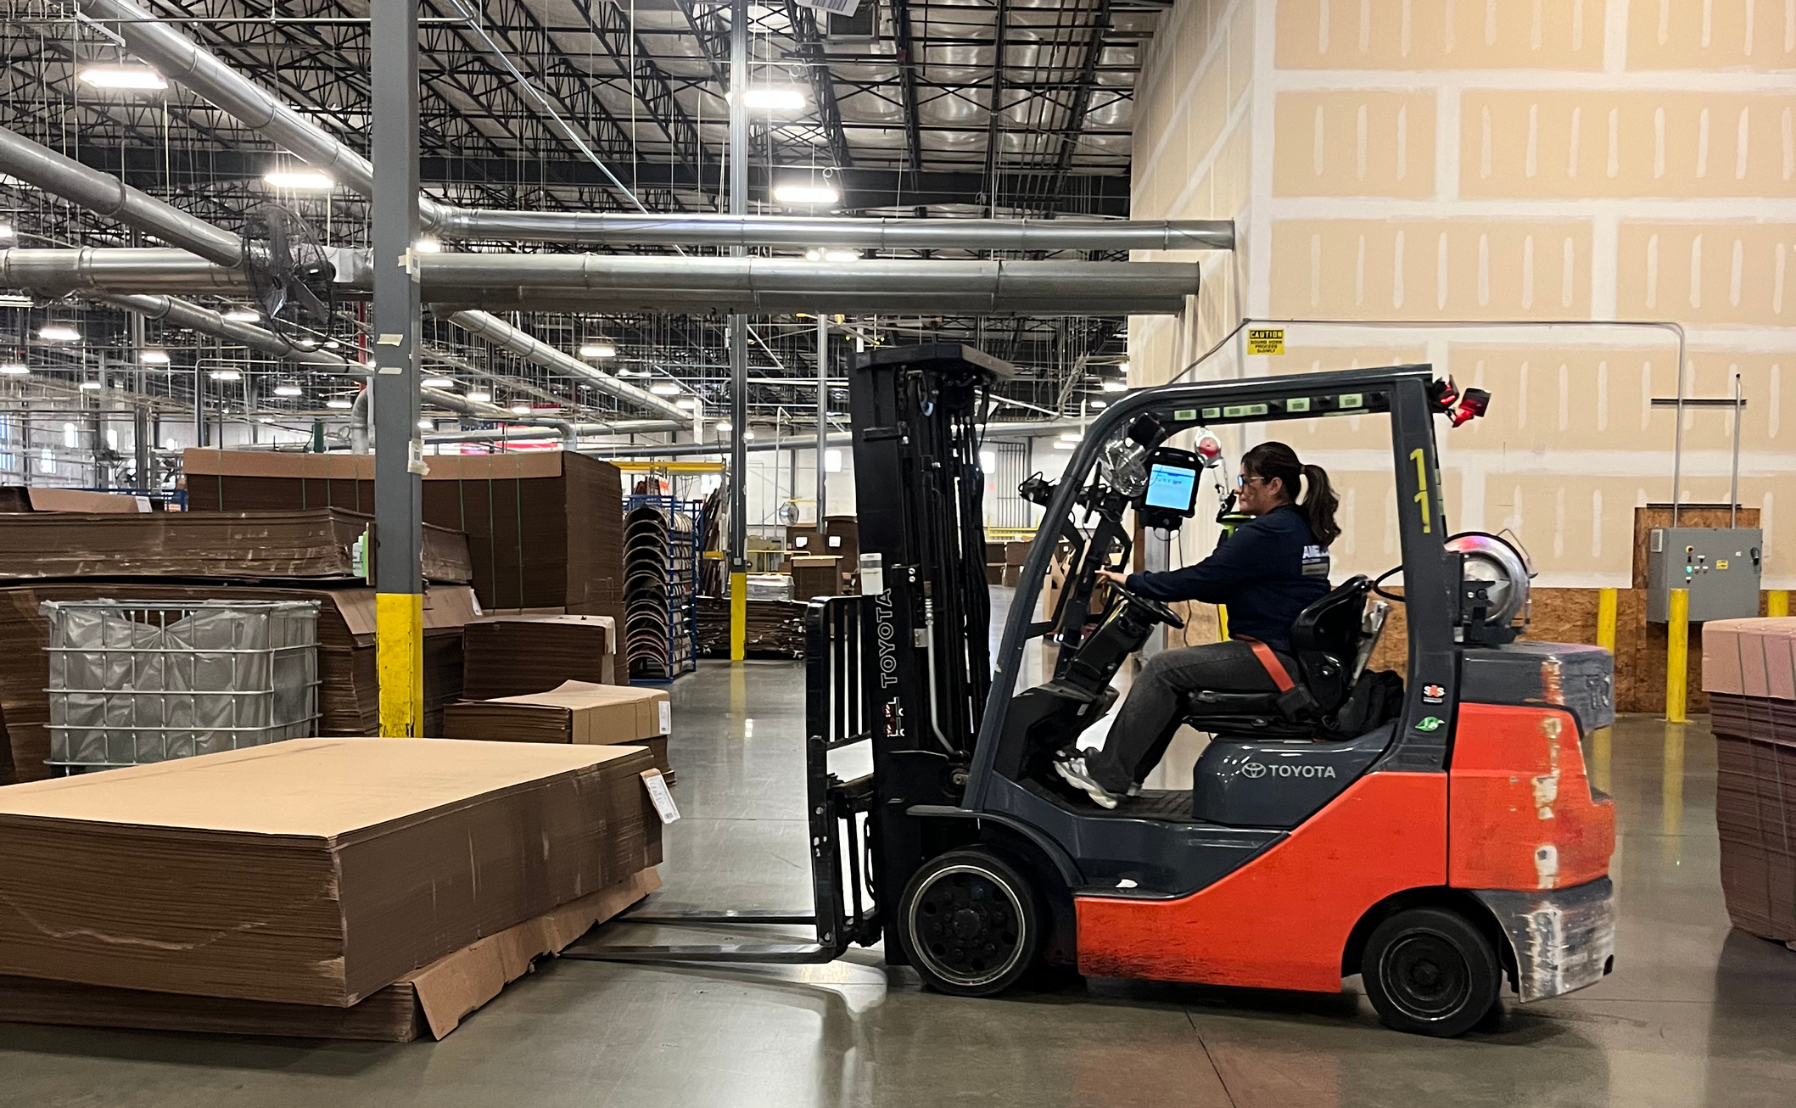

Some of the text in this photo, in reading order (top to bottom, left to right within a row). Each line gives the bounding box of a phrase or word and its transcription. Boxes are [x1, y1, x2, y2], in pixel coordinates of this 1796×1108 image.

[875, 588, 898, 688] TOYOTA
[1423, 684, 1445, 697] SAS
[1268, 765, 1336, 778] TOYOTA
